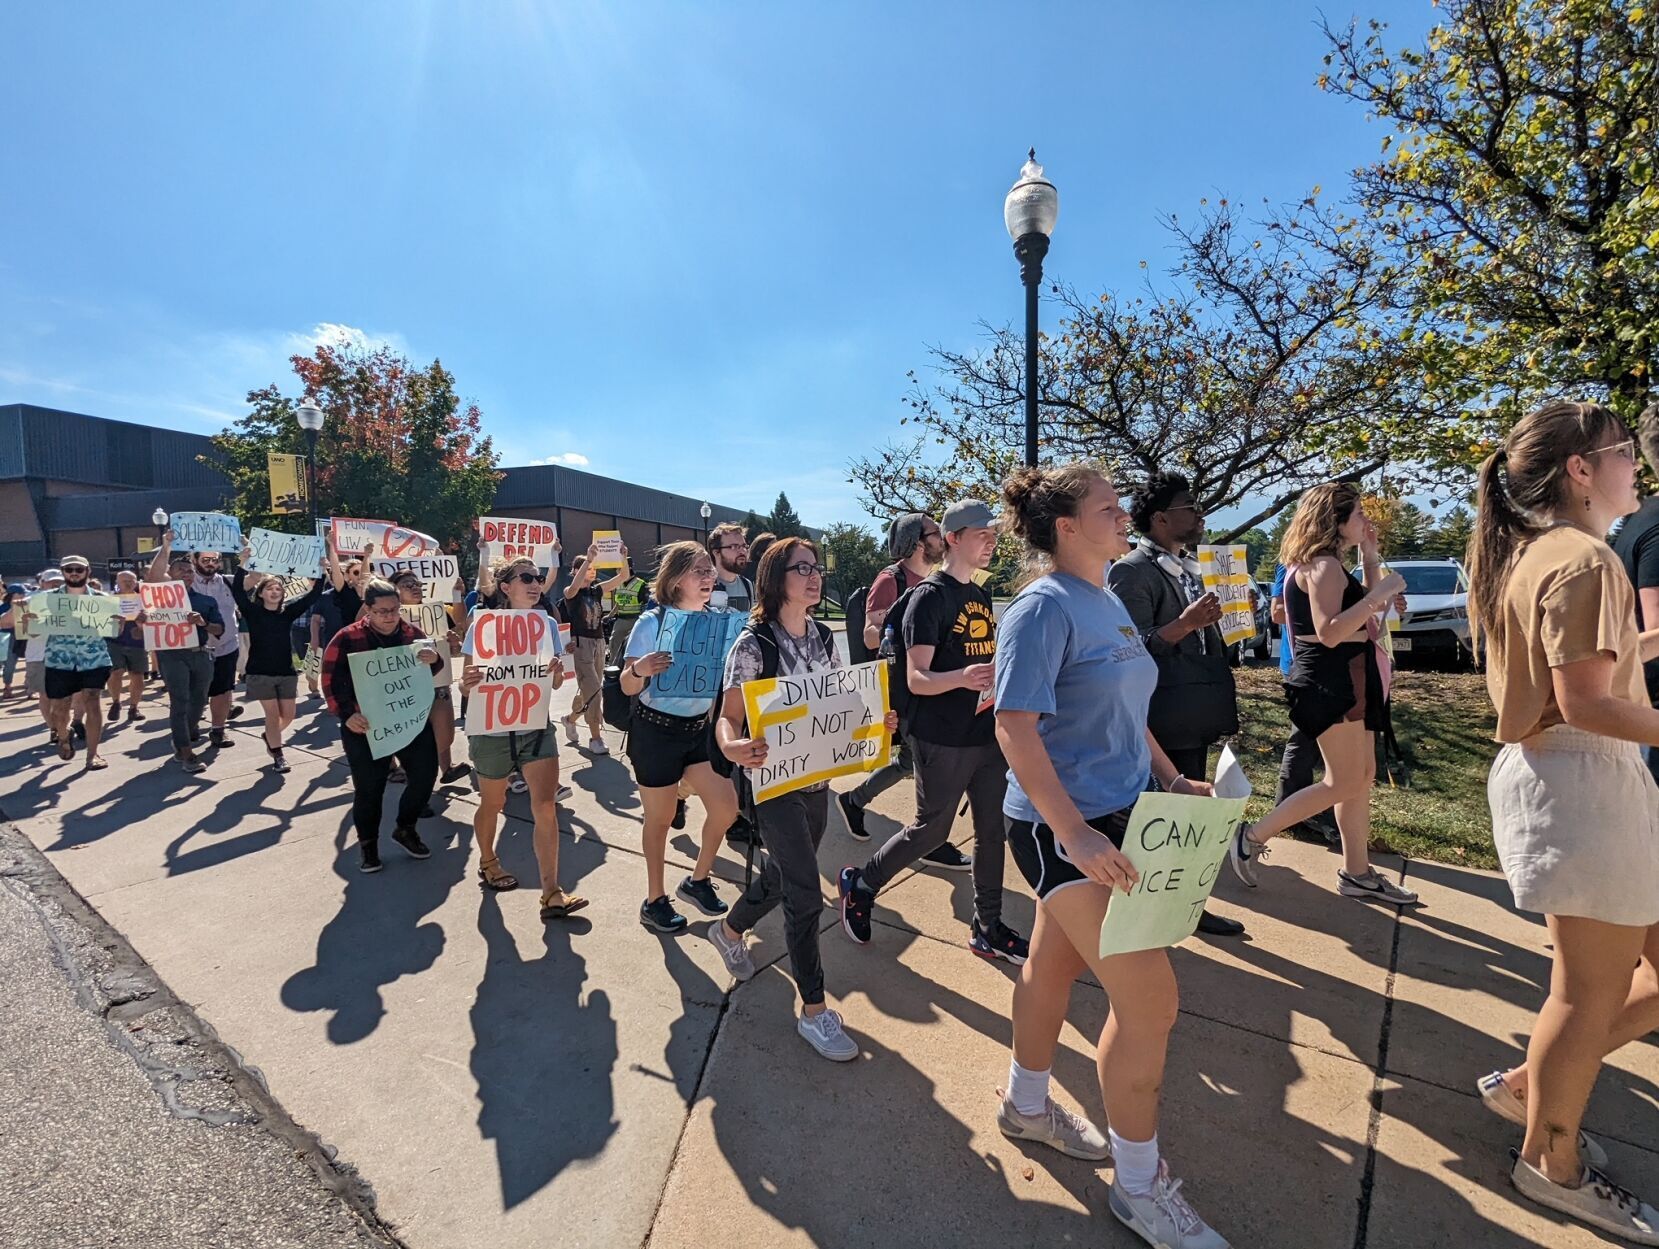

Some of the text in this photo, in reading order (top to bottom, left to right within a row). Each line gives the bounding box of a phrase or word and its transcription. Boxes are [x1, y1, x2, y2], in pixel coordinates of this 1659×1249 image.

[483, 521, 554, 544] DEFEND
[503, 544, 534, 561] DEI
[58, 597, 100, 613] FUND
[140, 584, 185, 609] CHOP
[1216, 584, 1247, 604] STUDENT
[45, 616, 112, 629] THE UW
[174, 611, 188, 621] TH
[952, 601, 994, 634] UW OSHKOS
[143, 621, 193, 648] TOP
[474, 612, 545, 660] CHOP
[963, 640, 995, 657] TITANS
[366, 654, 416, 677] CLEAN
[519, 664, 548, 680] THE
[384, 676, 412, 694] OUT
[656, 664, 722, 693] CABI
[780, 664, 878, 706] DIVERSITY
[386, 695, 416, 712] THE
[478, 683, 541, 731] TOP
[778, 706, 873, 747] IS NOT A
[760, 740, 876, 786] DIRTY WORD
[1141, 817, 1238, 851] CAN I
